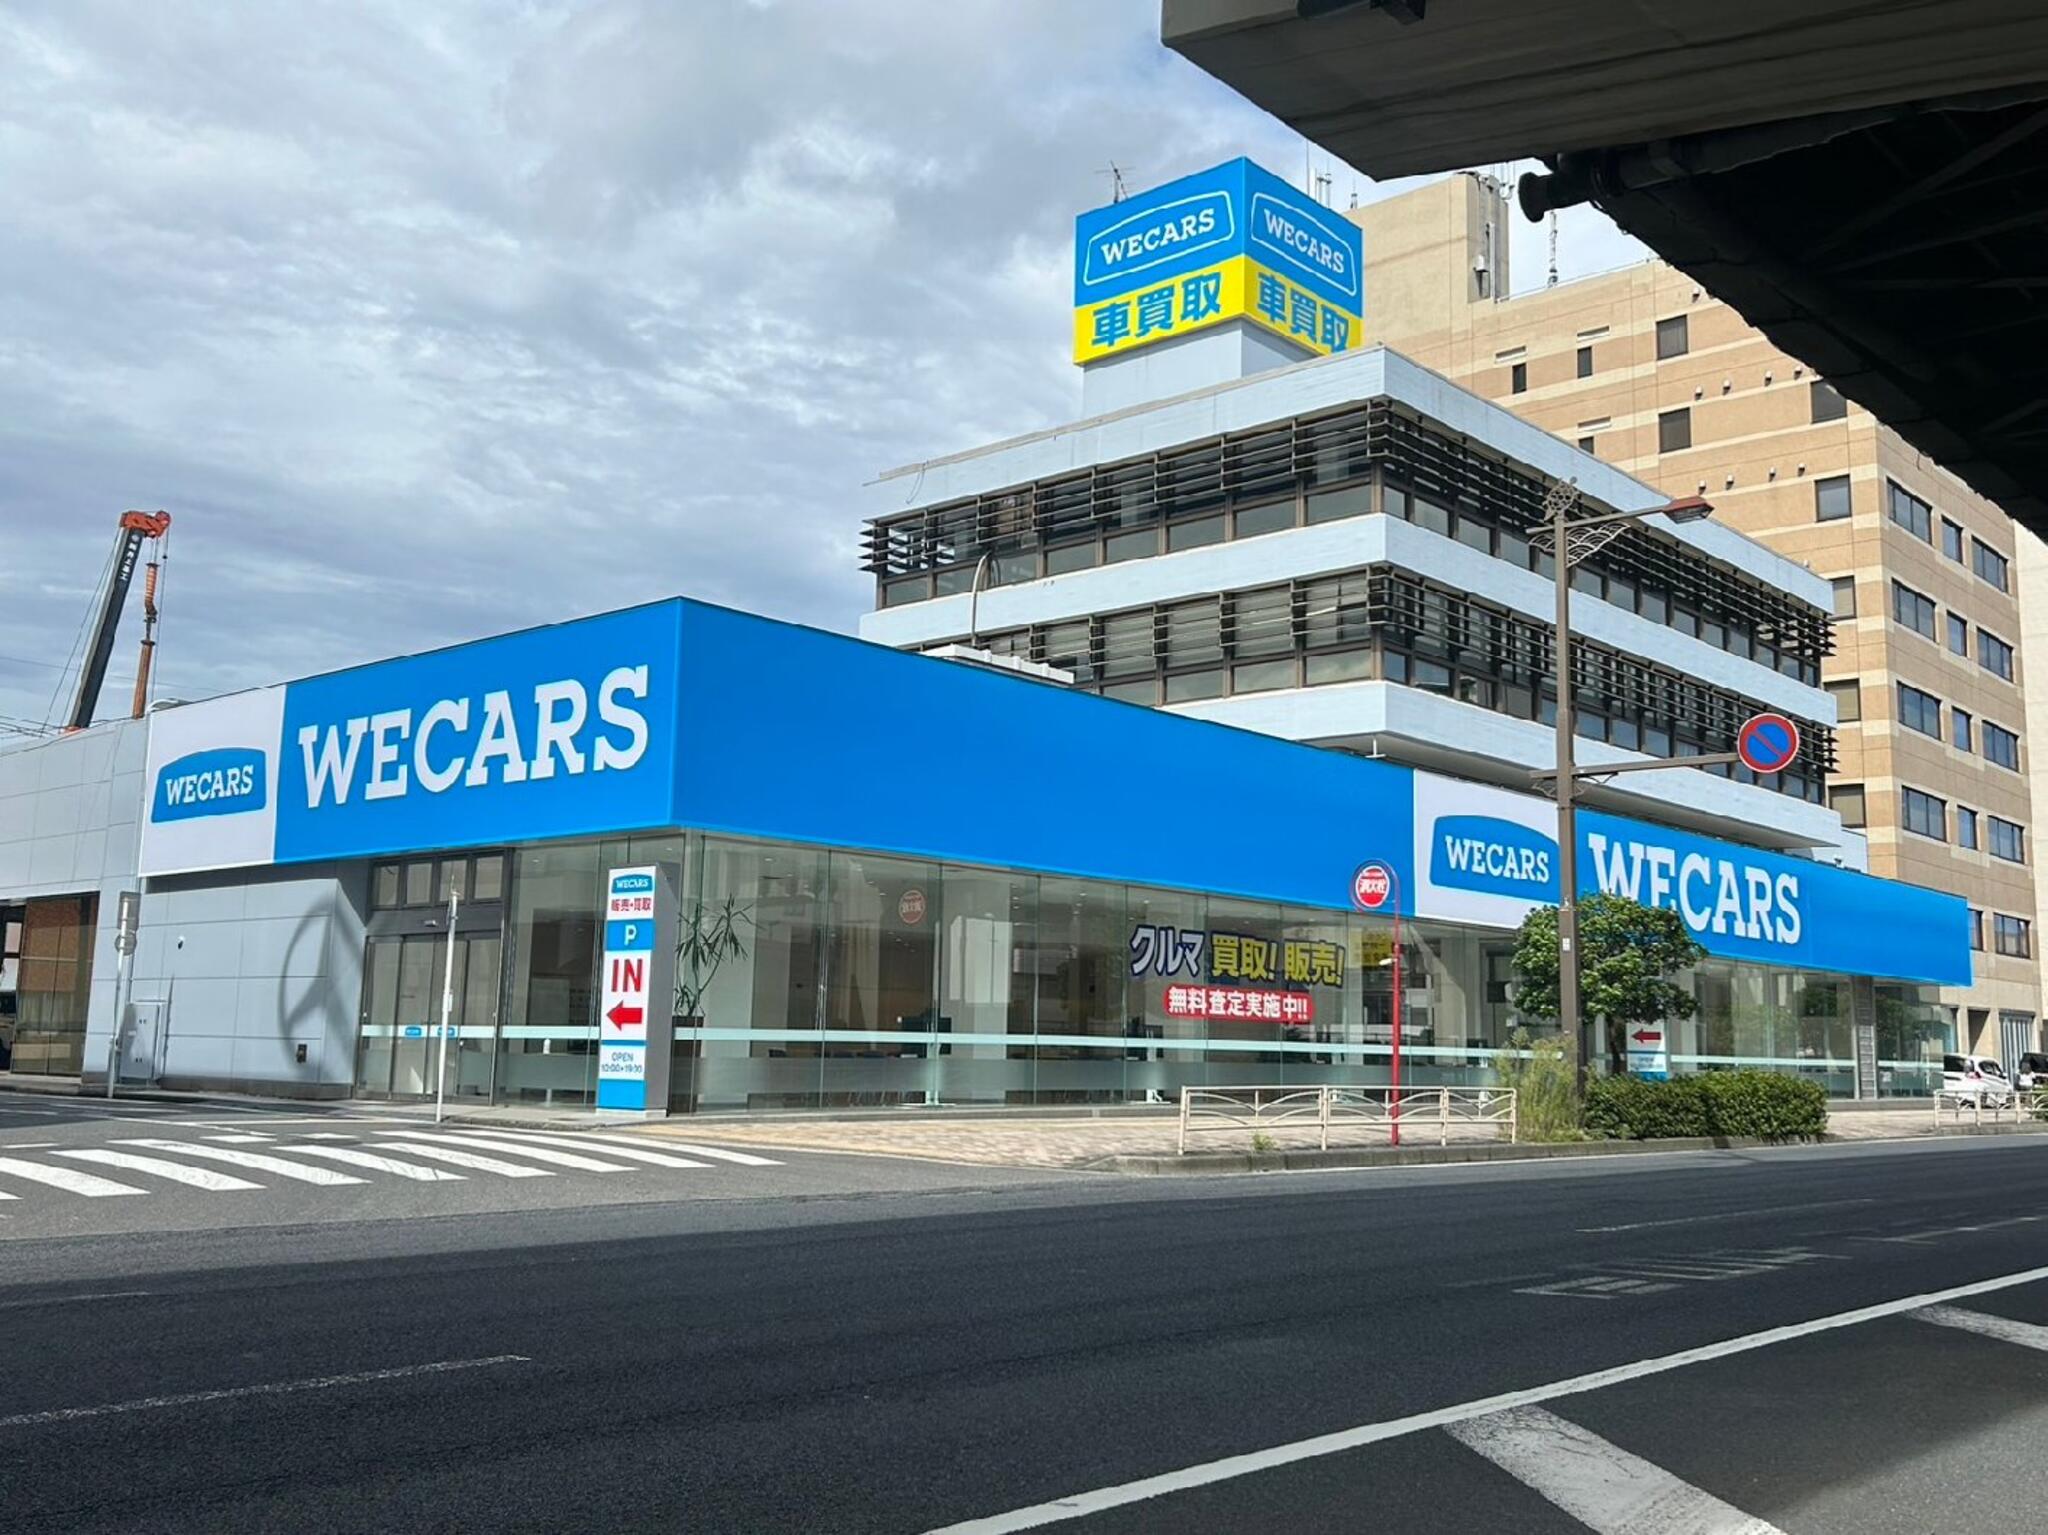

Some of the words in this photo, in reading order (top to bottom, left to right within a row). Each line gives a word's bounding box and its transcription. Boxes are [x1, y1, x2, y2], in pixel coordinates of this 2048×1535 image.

[1101, 207, 1215, 265] WECARS
[1263, 208, 1345, 275] WECARS
[1091, 271, 1223, 347] 車買取
[1258, 271, 1349, 353] 車買取
[299, 664, 650, 808] WECARS
[165, 763, 255, 806] WECARS
[615, 878, 649, 889] WECARS
[1445, 835, 1550, 884] WECARS
[1588, 832, 1802, 945] WECARS
[624, 925, 637, 946] P
[1130, 925, 1205, 976] クルマ
[610, 958, 643, 993] IN
